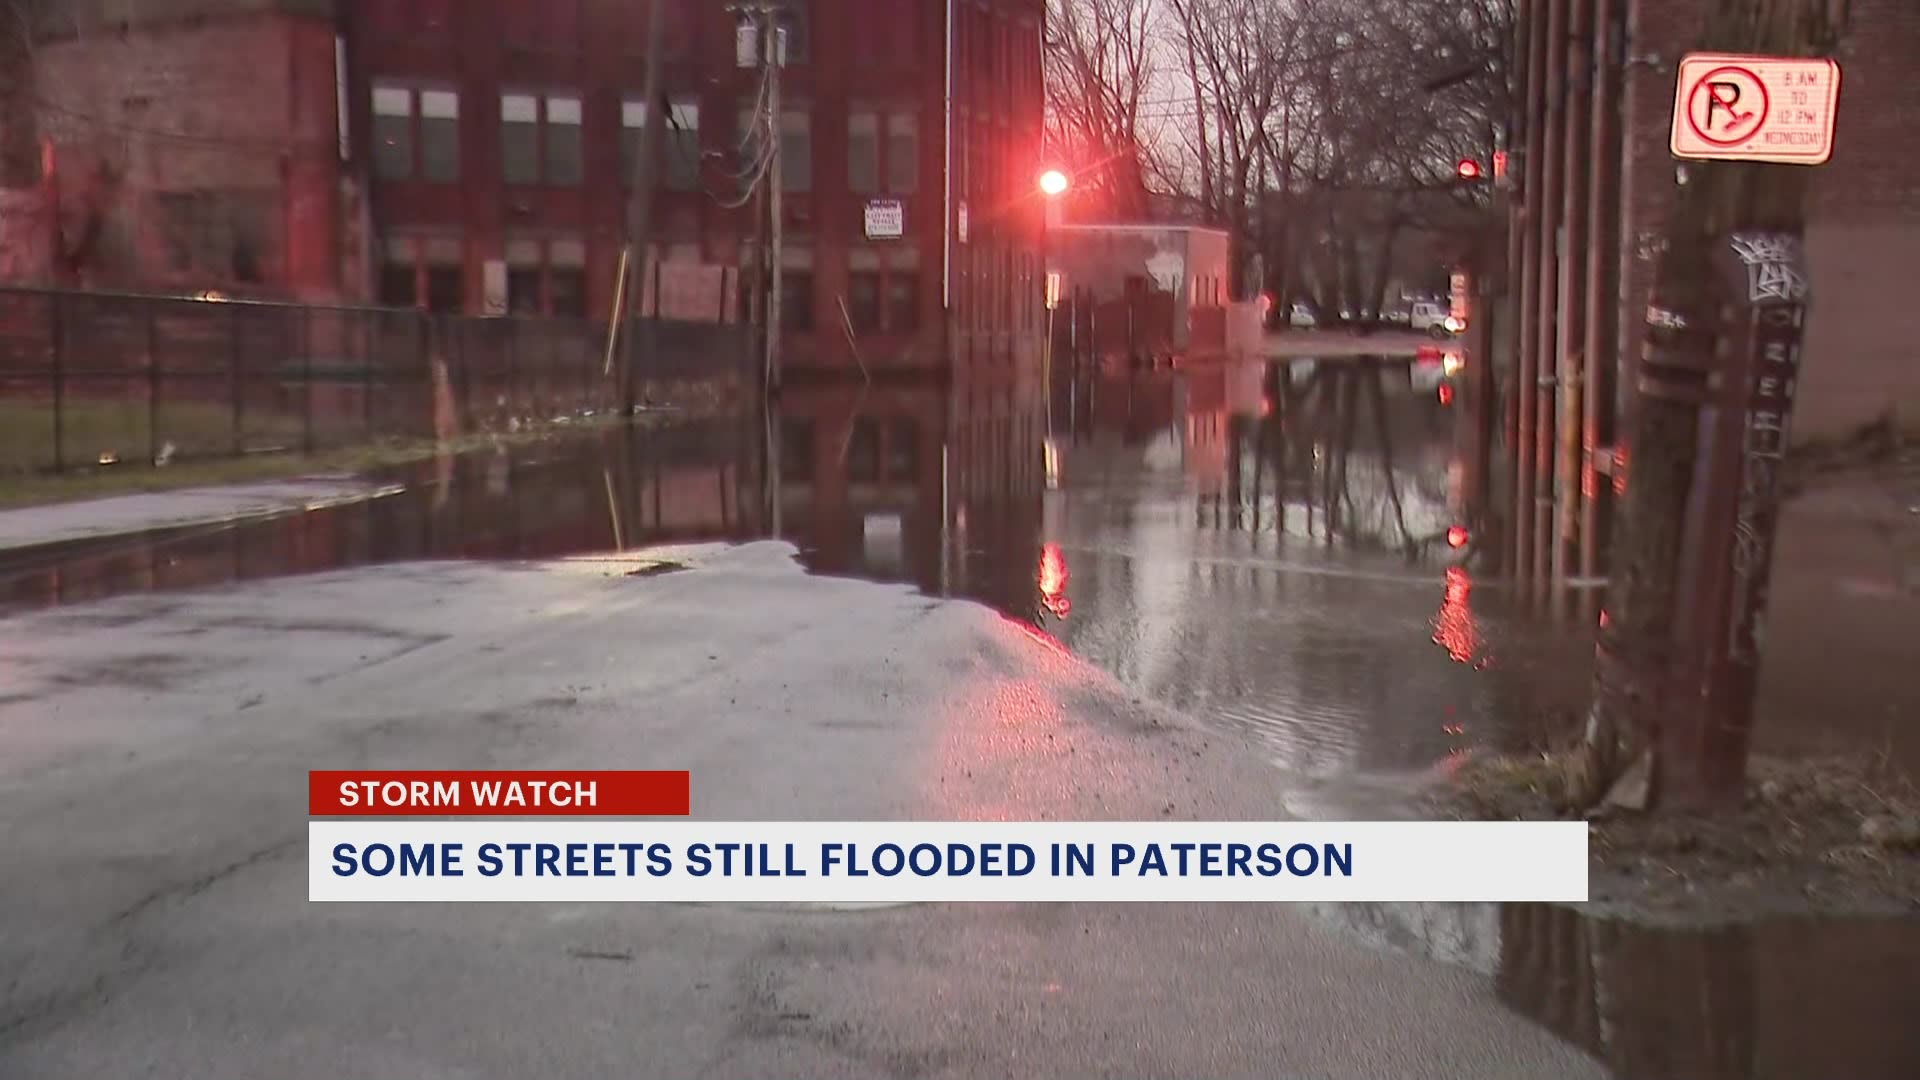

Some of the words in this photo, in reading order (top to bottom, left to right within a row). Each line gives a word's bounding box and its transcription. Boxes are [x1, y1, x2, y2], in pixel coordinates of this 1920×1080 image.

[1796, 71, 1818, 87] AM
[1791, 91, 1808, 106] TO
[1777, 109, 1792, 124] 12
[1796, 109, 1817, 125] PM
